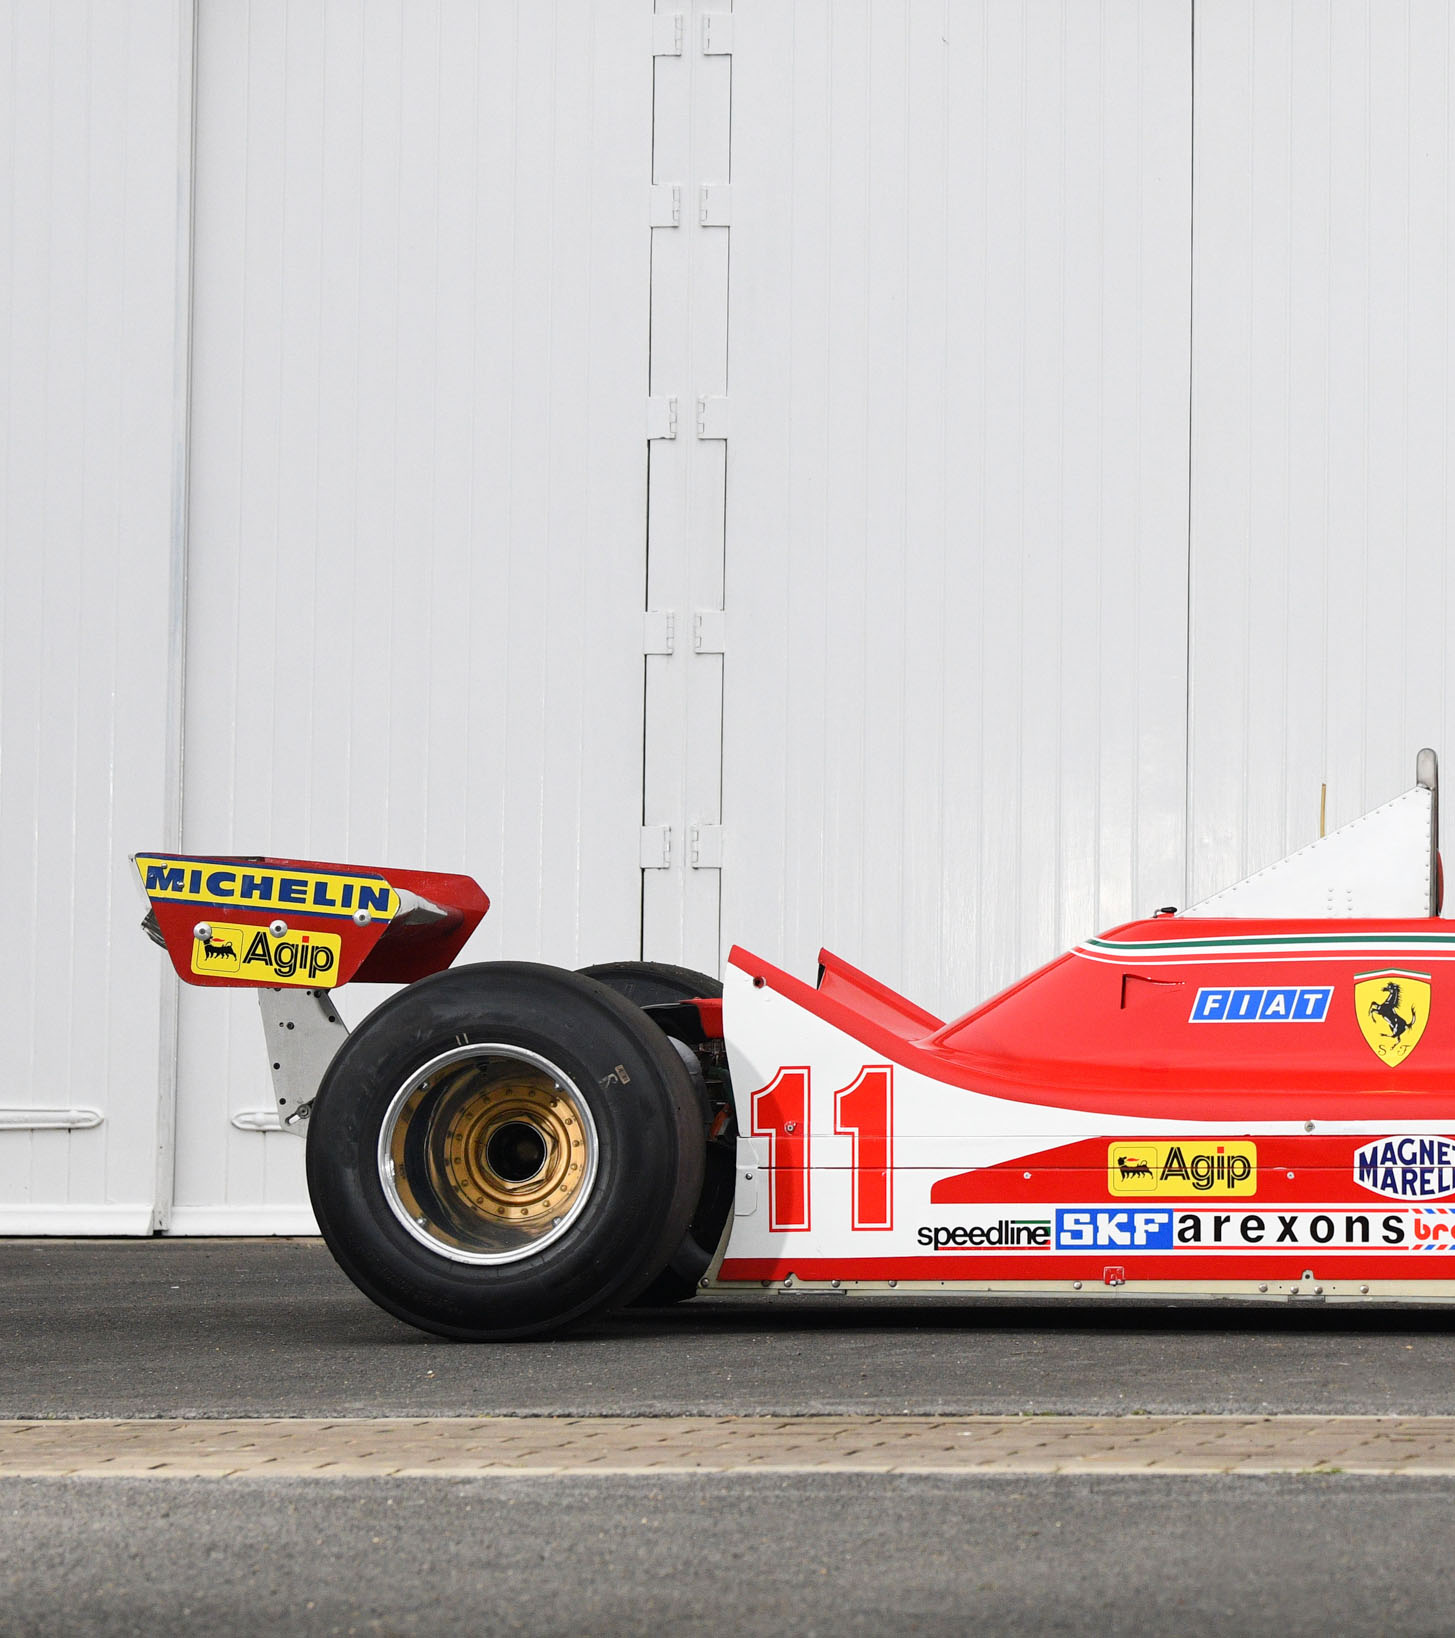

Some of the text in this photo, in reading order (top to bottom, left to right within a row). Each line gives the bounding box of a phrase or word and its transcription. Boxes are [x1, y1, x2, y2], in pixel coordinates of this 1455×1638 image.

[145, 865, 390, 912] MICHELIN
[242, 931, 334, 979] Agip
[1203, 994, 1323, 1016] FIAT
[751, 1065, 893, 1232] 11
[1159, 1146, 1252, 1191] Agip
[917, 1220, 1050, 1250] speedline
[1061, 1214, 1168, 1245] SKF
[1178, 1215, 1404, 1243] arexons
